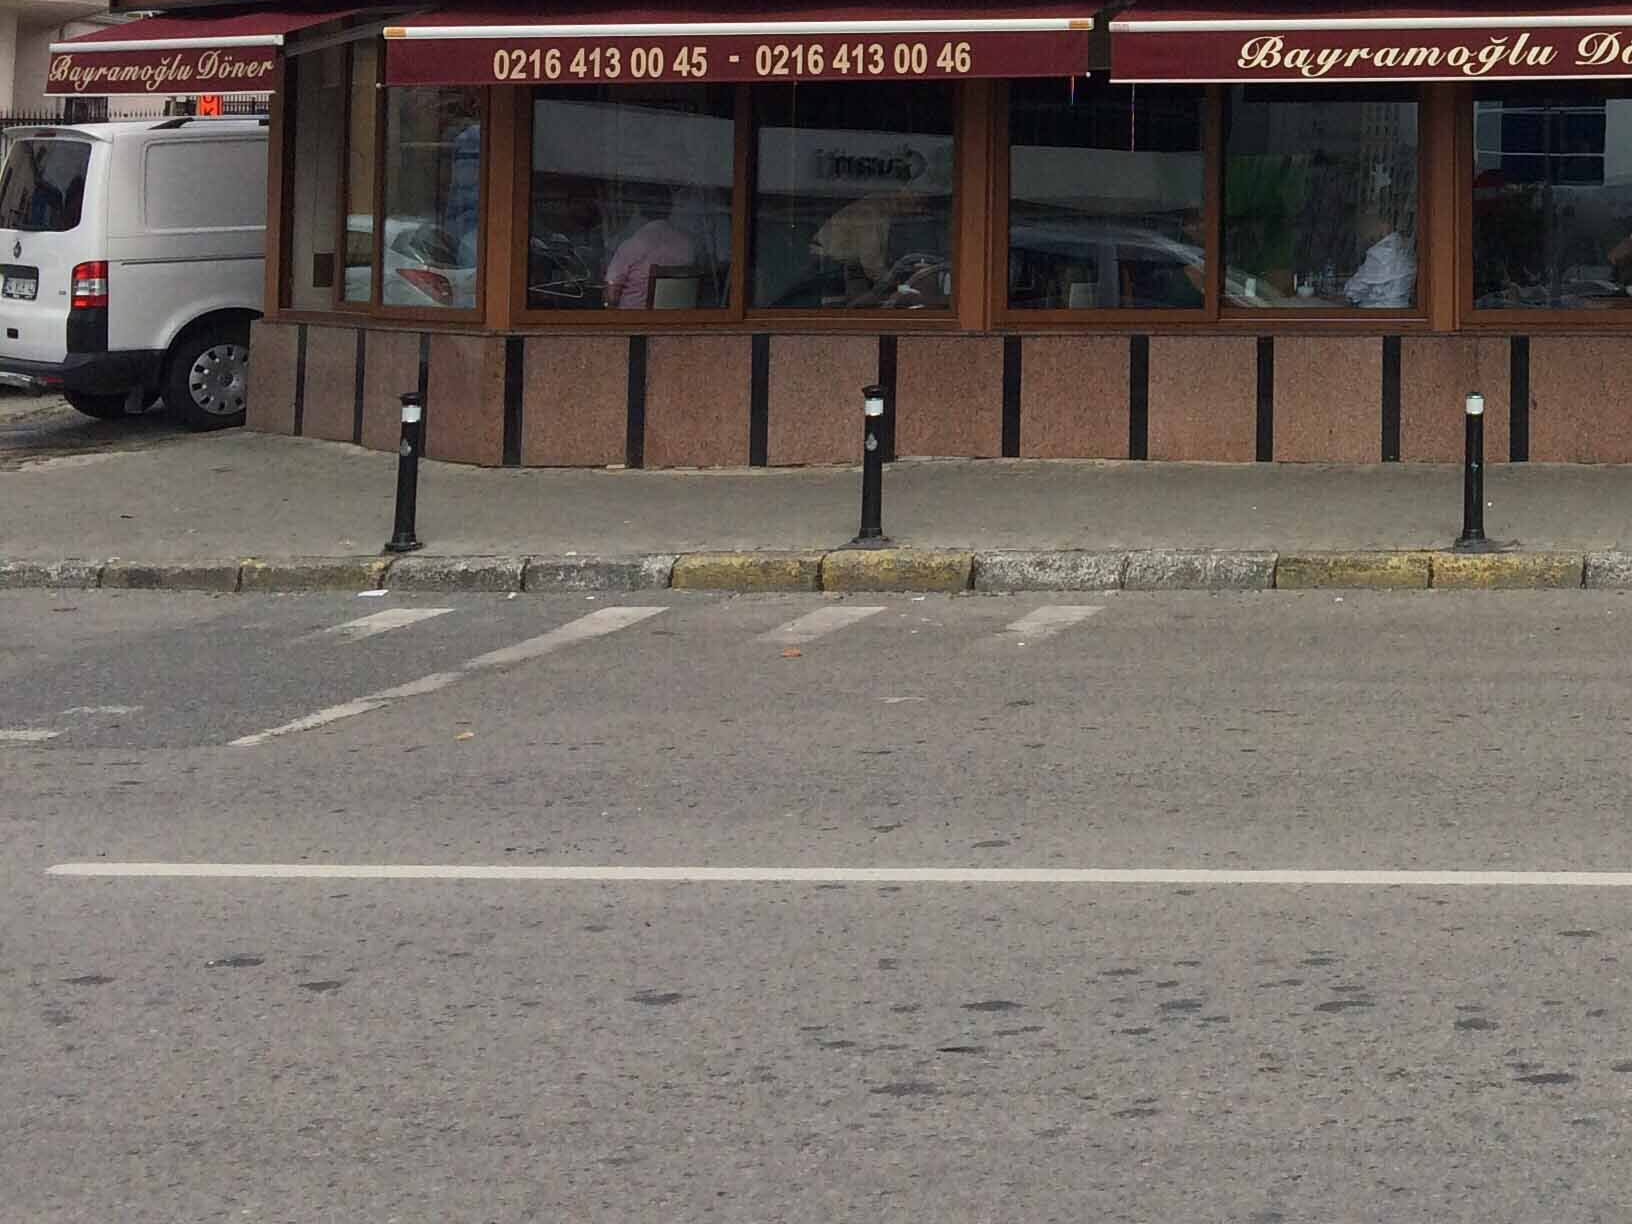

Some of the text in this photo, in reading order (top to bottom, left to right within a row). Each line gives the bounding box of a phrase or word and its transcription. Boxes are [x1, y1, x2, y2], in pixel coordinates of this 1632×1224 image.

[50, 50, 275, 92] Bayramoğlu Döner
[493, 49, 562, 80] 0216
[569, 48, 622, 79] 413
[630, 48, 665, 78] 00
[672, 47, 709, 78] 45
[755, 44, 825, 76] 0216
[832, 43, 887, 76] 413
[894, 43, 929, 75] 00
[936, 42, 973, 74] 46
[1237, 34, 1560, 78] Bayramoğlu
